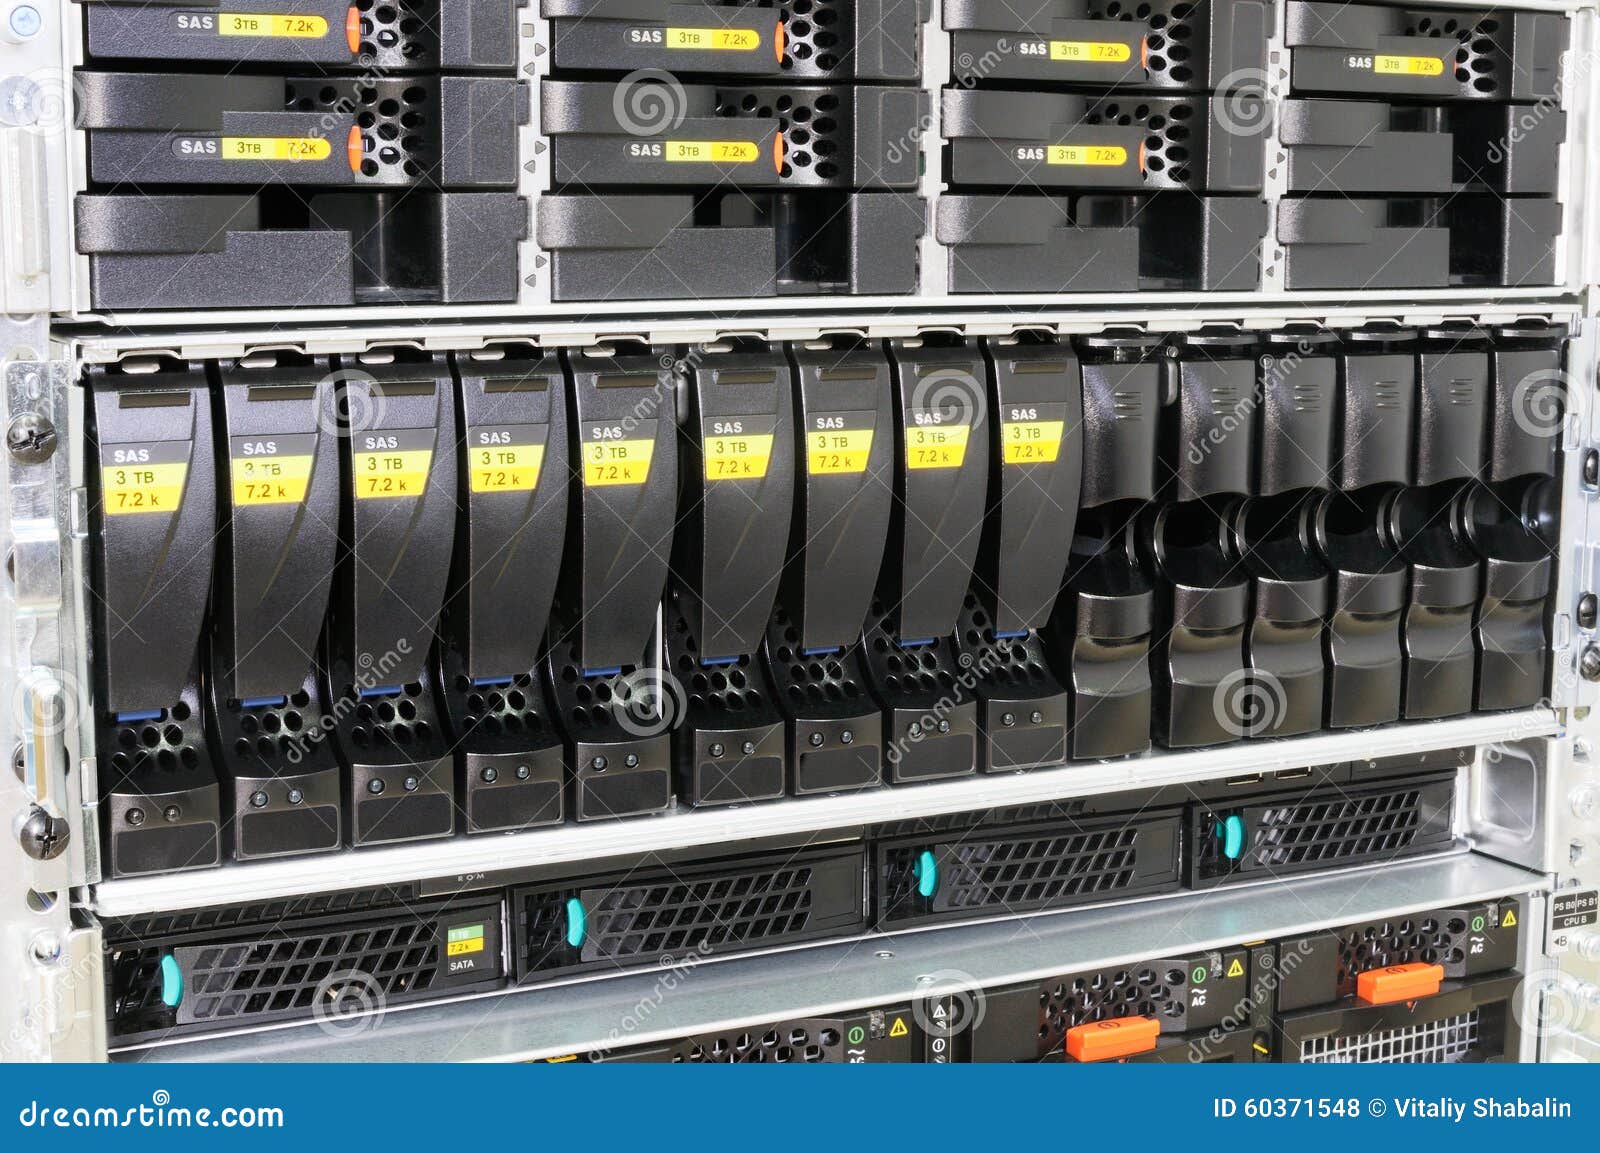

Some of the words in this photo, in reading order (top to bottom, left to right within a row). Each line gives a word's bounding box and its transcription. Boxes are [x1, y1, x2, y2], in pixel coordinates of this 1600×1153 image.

[177, 15, 213, 29] SAS
[234, 18, 258, 30] 3TB
[631, 30, 662, 43] SAS
[679, 32, 700, 44] 3TB
[1019, 43, 1047, 55] SAS
[1061, 45, 1079, 56] 3TB
[1348, 56, 1372, 68] SAS
[1384, 59, 1400, 69] 3TB
[181, 140, 217, 154] SAS
[237, 142, 261, 154] 3TB
[630, 144, 662, 156] SAS
[678, 145, 700, 157] 3TB
[1017, 148, 1044, 160] SAS
[1058, 149, 1077, 160] 3TB
[915, 412, 942, 425] SAS
[1011, 408, 1037, 420] SAS
[713, 422, 743, 434] SAS
[816, 417, 844, 430] SAS
[480, 431, 511, 445] SAS
[592, 426, 622, 440] SAS
[916, 431, 924, 443] 3
[930, 432, 946, 443] TB
[1013, 427, 1021, 439] 3
[1026, 428, 1041, 438] TB
[243, 441, 277, 455] SAS
[365, 436, 398, 450] SAS
[716, 441, 724, 454] 3
[729, 442, 748, 453] TB
[818, 435, 826, 448] 3
[832, 436, 848, 448] TB
[114, 449, 149, 463] SAS
[482, 451, 491, 465] 3
[497, 453, 516, 464] TB
[609, 447, 627, 459] TB
[917, 450, 937, 463] 7.2
[1013, 446, 1032, 458] 7.2
[367, 457, 377, 471] 3
[384, 458, 403, 470] TB
[716, 460, 738, 474] 7.2
[818, 455, 839, 468] 7.2
[116, 471, 126, 485] 3
[134, 472, 155, 484] TB
[482, 472, 505, 486] 7.2
[595, 466, 618, 480] 7.2
[246, 484, 270, 498] 7.2
[368, 478, 392, 492] 7.2
[117, 493, 144, 507] 7.2
[457, 873, 485, 882] ROM
[1554, 903, 1564, 911] PS
[1577, 900, 1587, 908] PS
[1588, 898, 1598, 906] B1
[1564, 917, 1579, 927] CPU
[1580, 916, 1587, 924] B
[450, 943, 463, 952] 7.2
[1559, 936, 1568, 946] B
[1470, 943, 1483, 954] AC
[450, 960, 475, 971] SATA
[1191, 995, 1206, 1007] AC
